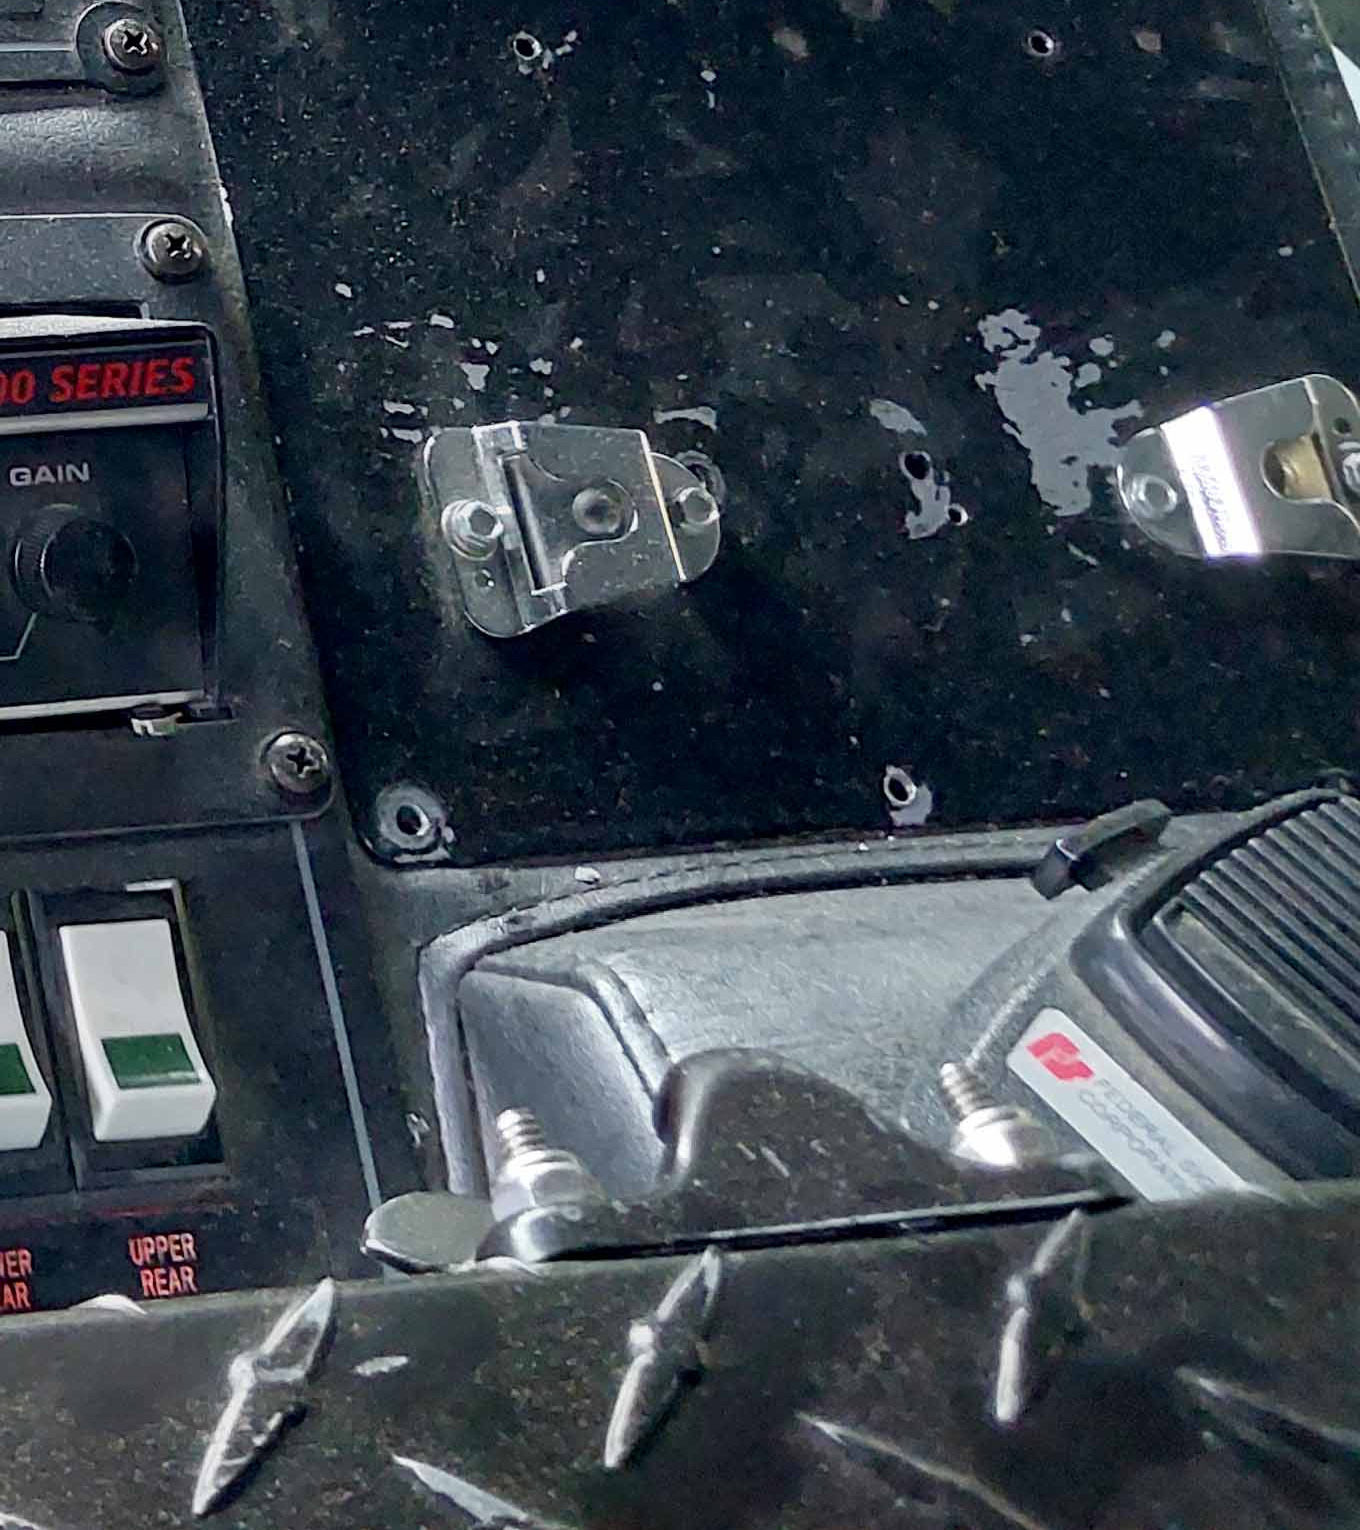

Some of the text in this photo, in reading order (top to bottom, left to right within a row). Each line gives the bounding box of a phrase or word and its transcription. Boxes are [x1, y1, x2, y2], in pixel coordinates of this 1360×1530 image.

[50, 356, 195, 404] SERIES
[9, 463, 91, 488] GAIN
[129, 1232, 197, 1266] UPPER
[140, 1266, 198, 1299] REAR
